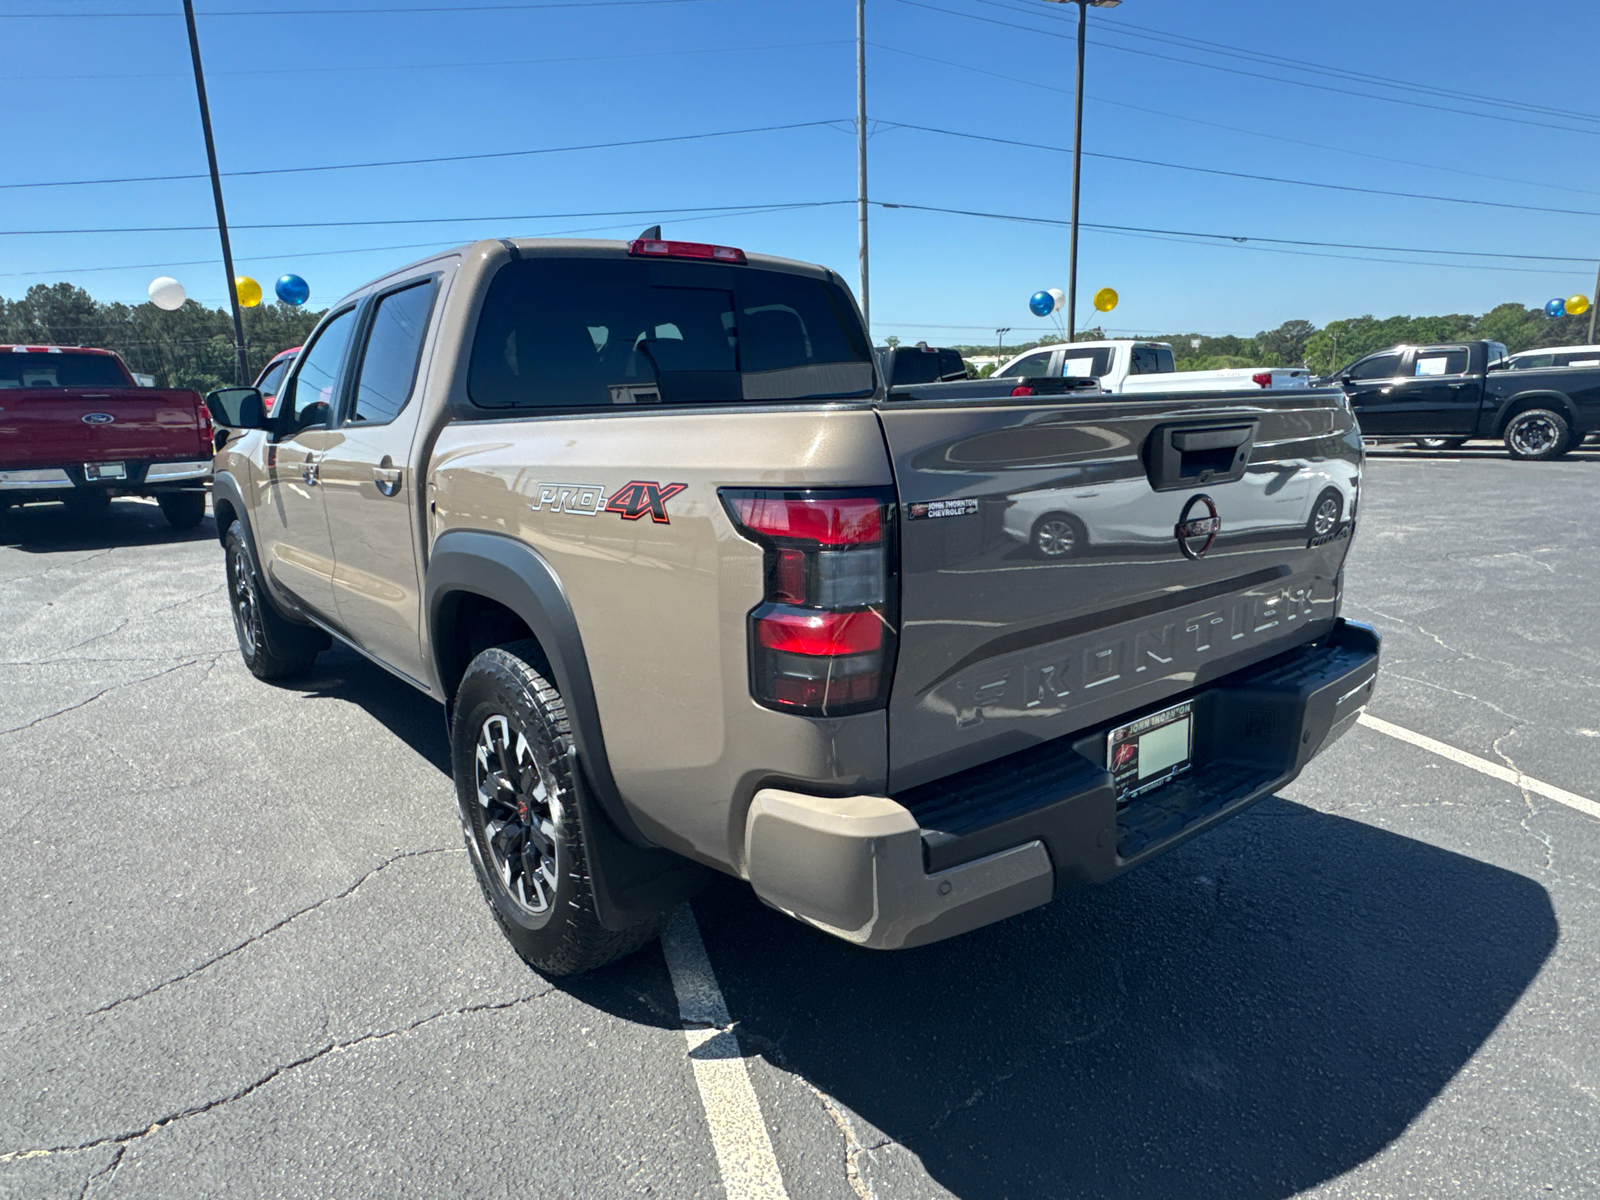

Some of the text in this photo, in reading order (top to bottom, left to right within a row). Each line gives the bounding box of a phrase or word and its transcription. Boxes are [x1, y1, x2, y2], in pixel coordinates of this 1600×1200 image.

[928, 498, 978, 510] JOHN THORNTON
[928, 507, 966, 518] CHEVROLET
[956, 585, 1314, 729] FRONTIER
[1129, 703, 1191, 734] JOHN THORNTON
